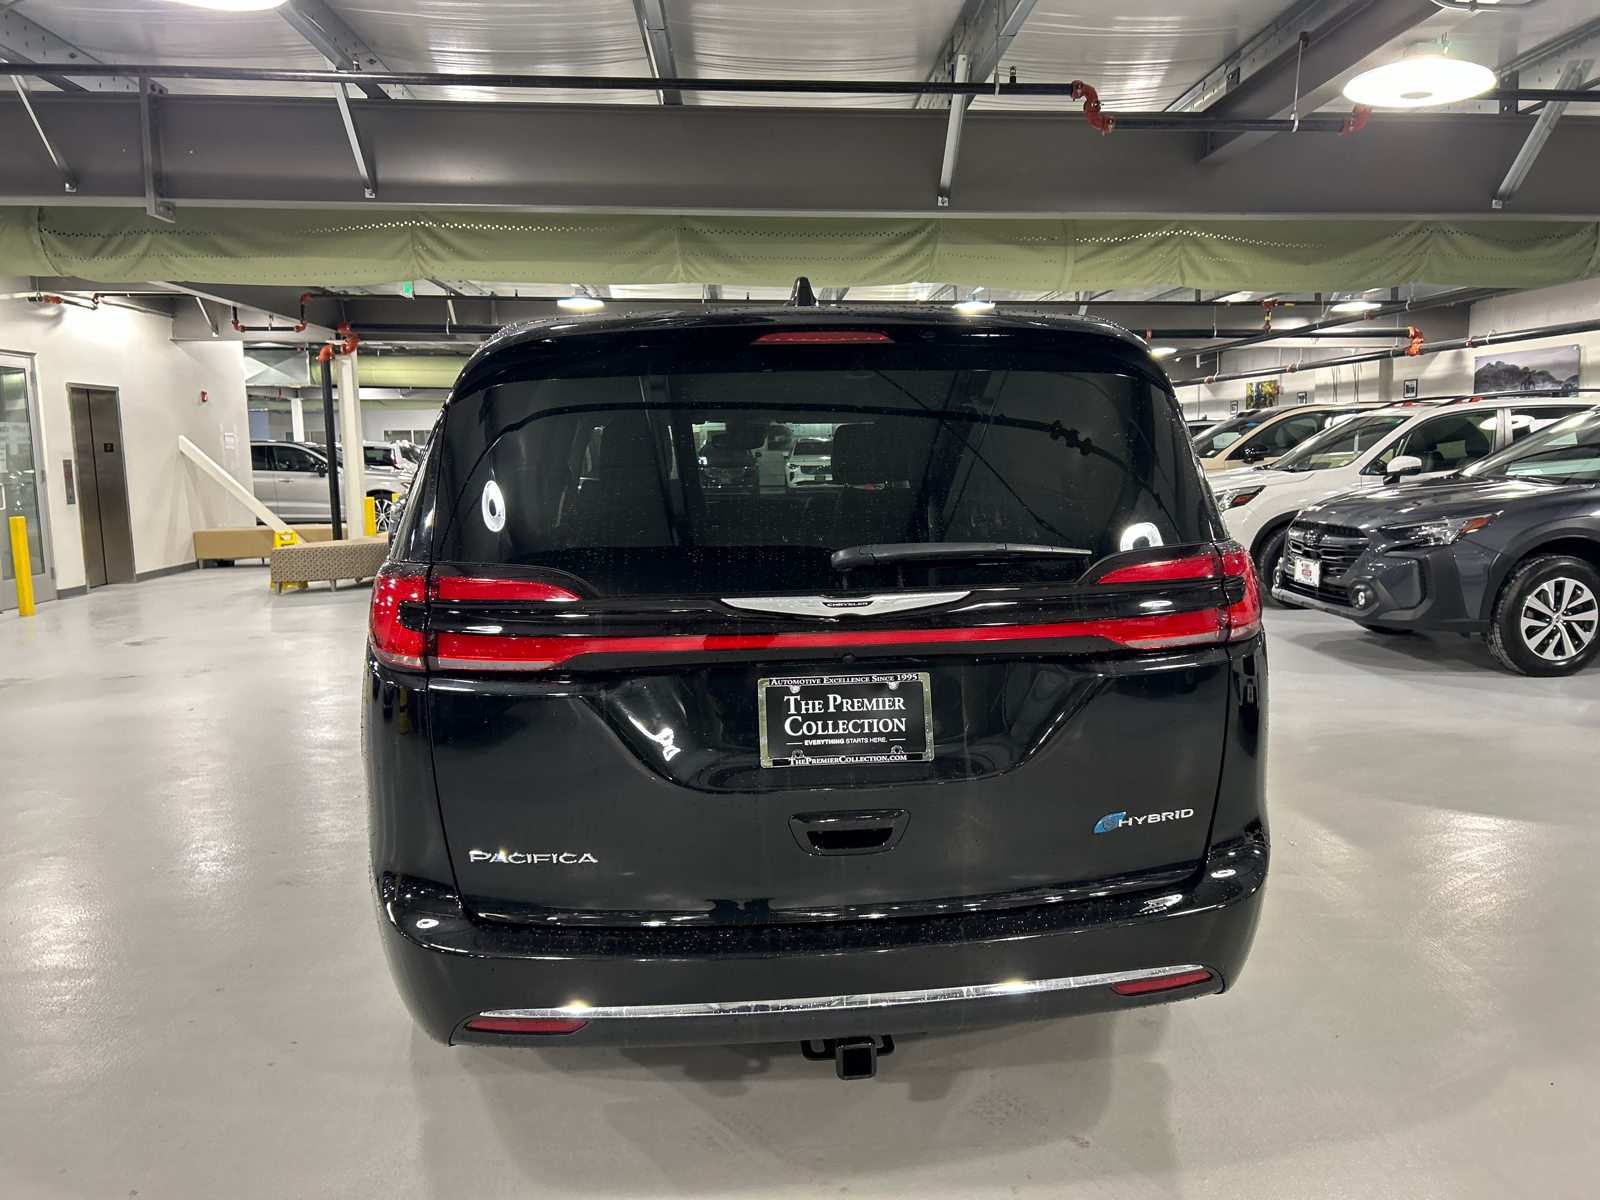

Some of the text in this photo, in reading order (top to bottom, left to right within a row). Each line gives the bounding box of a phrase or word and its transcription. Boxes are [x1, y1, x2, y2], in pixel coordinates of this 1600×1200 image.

[771, 678, 821, 686] AUTOMOTIVE
[897, 673, 918, 681] 1995
[784, 693, 906, 714] THE PREMIER
[784, 715, 907, 736] COLLECTION
[1118, 808, 1195, 828] HYBRID
[468, 850, 599, 864] PACIFICA
